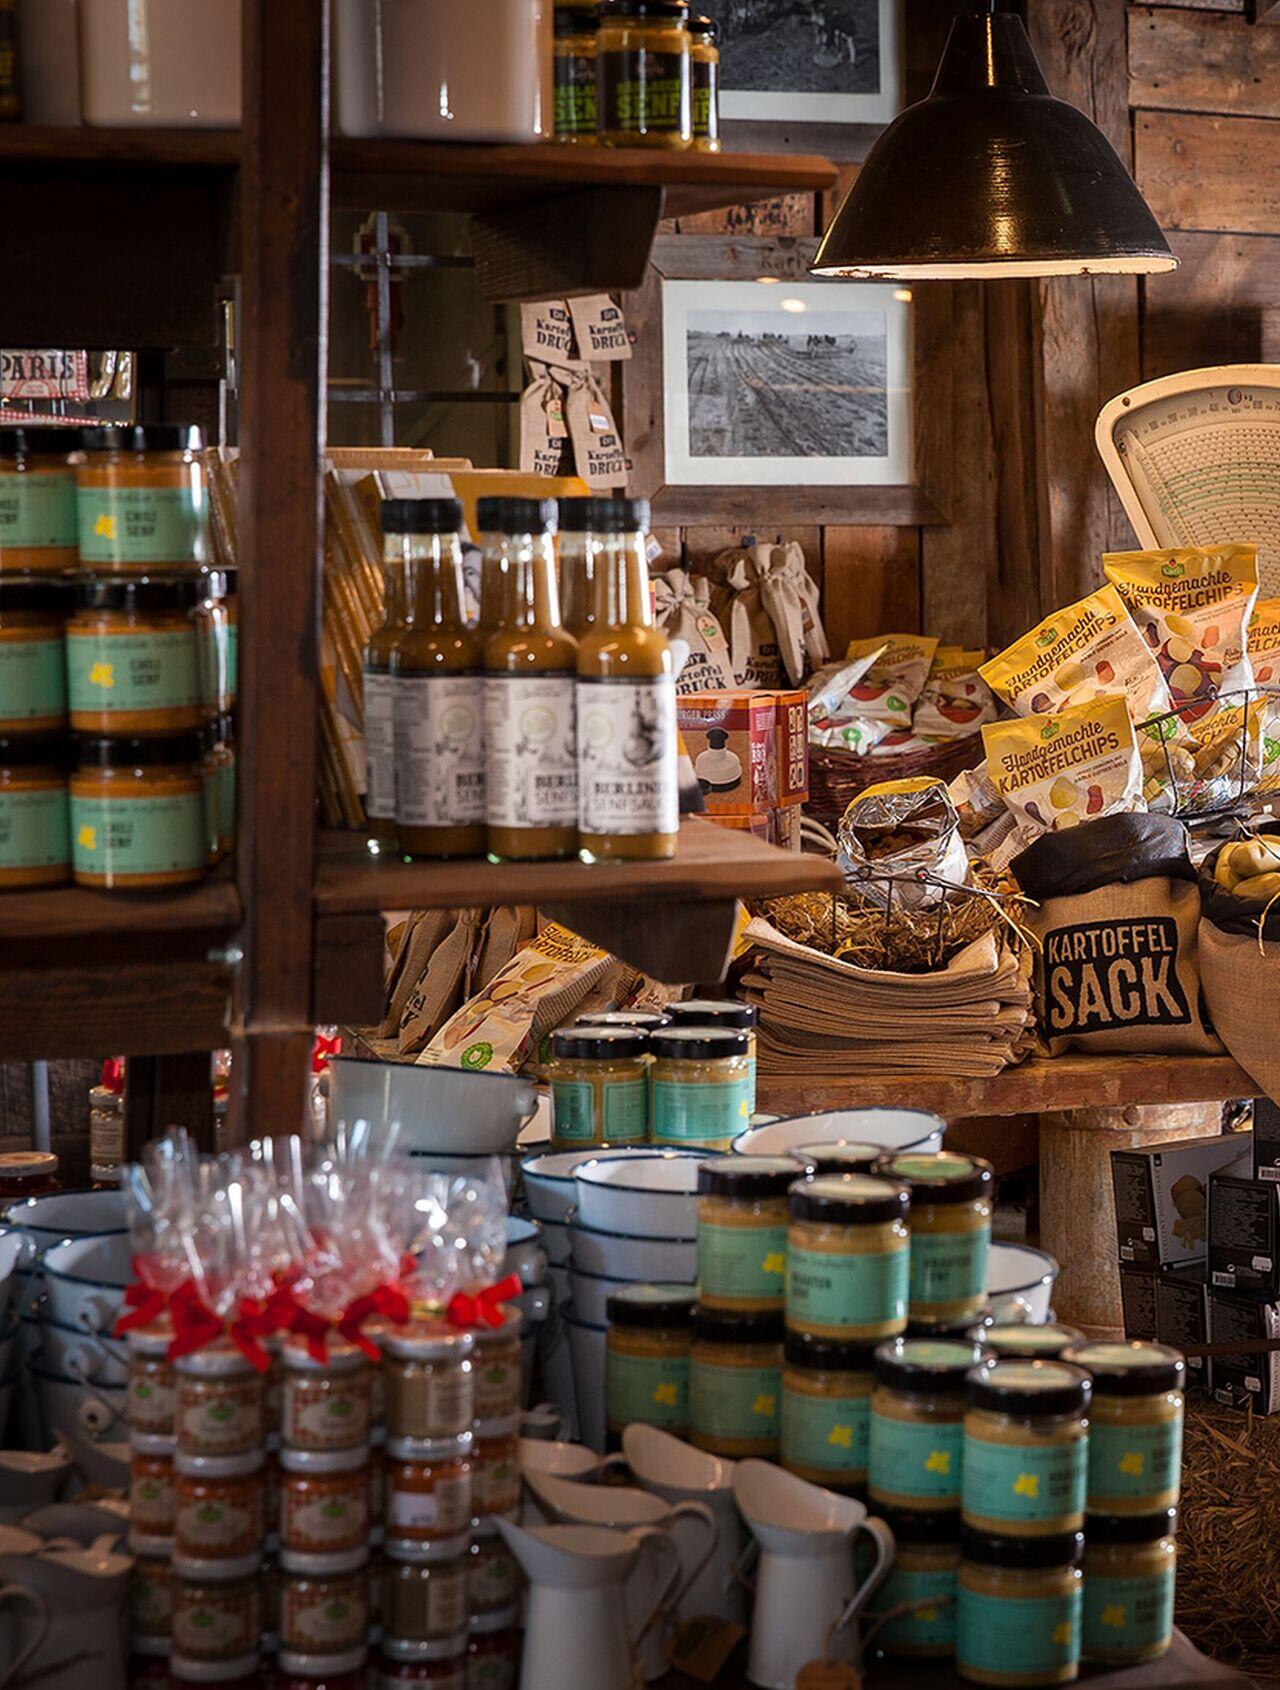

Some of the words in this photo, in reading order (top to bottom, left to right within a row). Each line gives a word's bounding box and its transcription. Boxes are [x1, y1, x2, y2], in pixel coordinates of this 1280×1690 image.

[536, 331, 572, 351] DRUC
[1117, 569, 1233, 597] Handgemachte
[1125, 582, 1245, 613] ARTOFFELCHIPS
[1005, 609, 1100, 688] Handgemachte
[1007, 612, 1118, 706] KARTOFFELCHIPS
[676, 664, 723, 684] artoffel
[998, 731, 1120, 796] KARTOFFELCHIPS
[1002, 720, 1105, 773] Handgemachte
[1048, 924, 1174, 965] KARTOFFEL
[1050, 956, 1184, 1030] SACK
